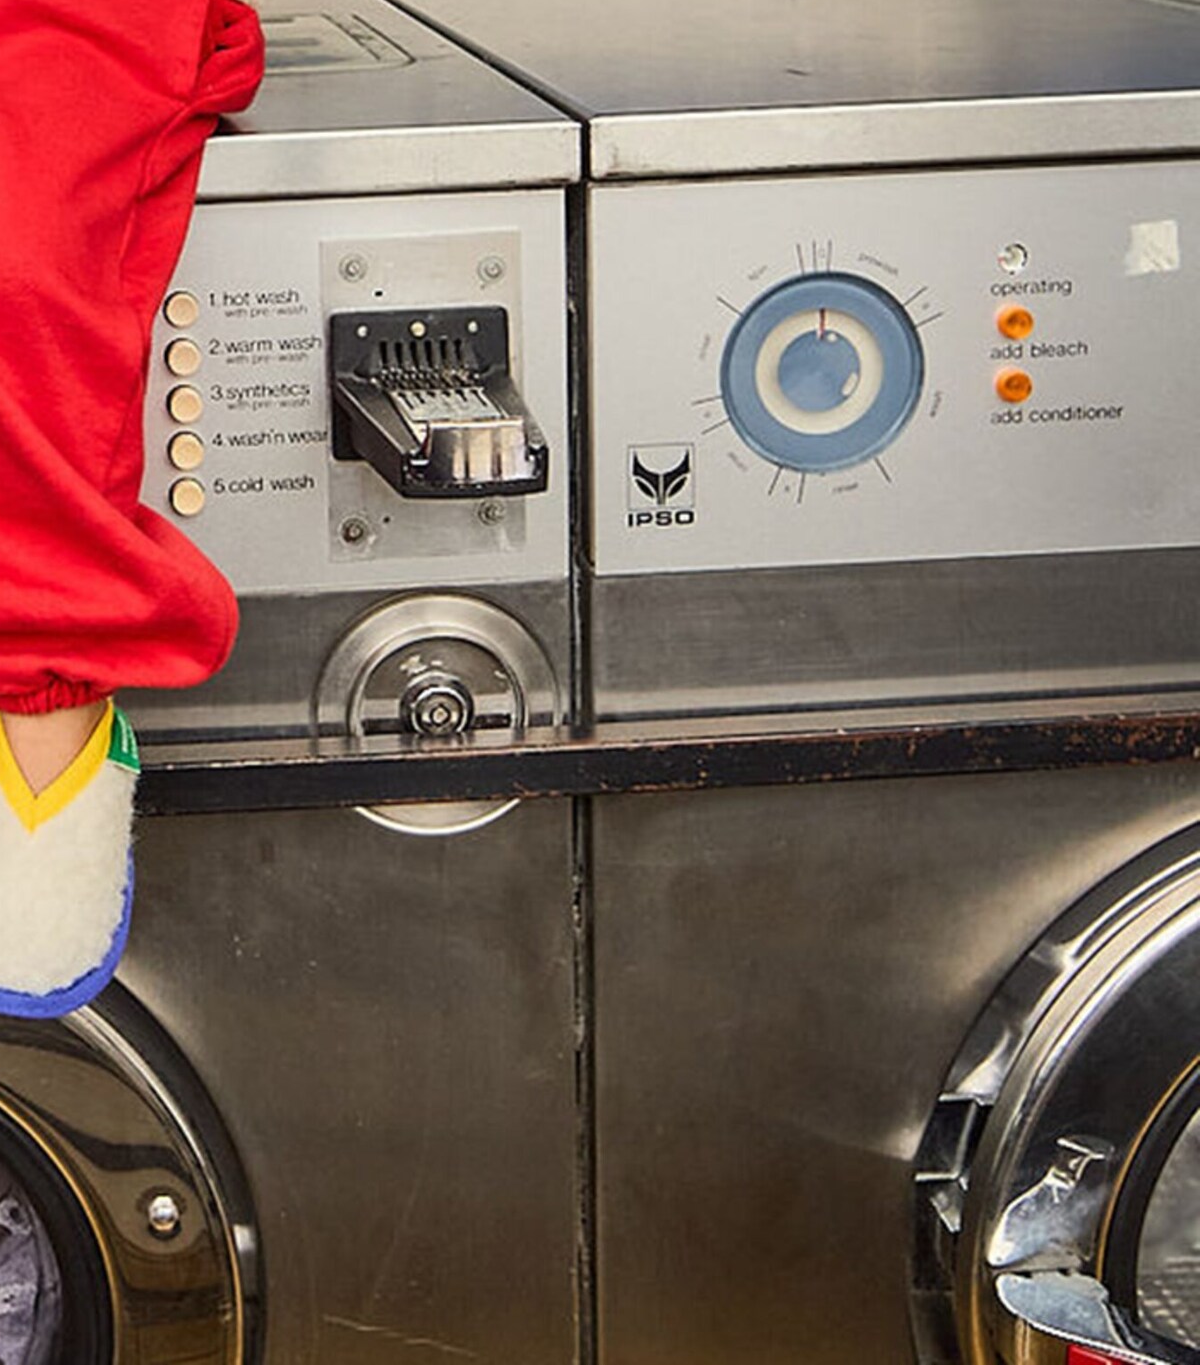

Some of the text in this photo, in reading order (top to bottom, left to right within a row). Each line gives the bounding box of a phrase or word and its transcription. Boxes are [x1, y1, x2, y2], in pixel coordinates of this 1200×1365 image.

[256, 288, 300, 304] wash
[989, 279, 1073, 297] operating
[277, 334, 322, 350] wash
[990, 341, 1089, 359] add bleach
[990, 405, 1124, 424] add conditioner
[270, 475, 315, 491] wash
[627, 510, 695, 528] IPSO
